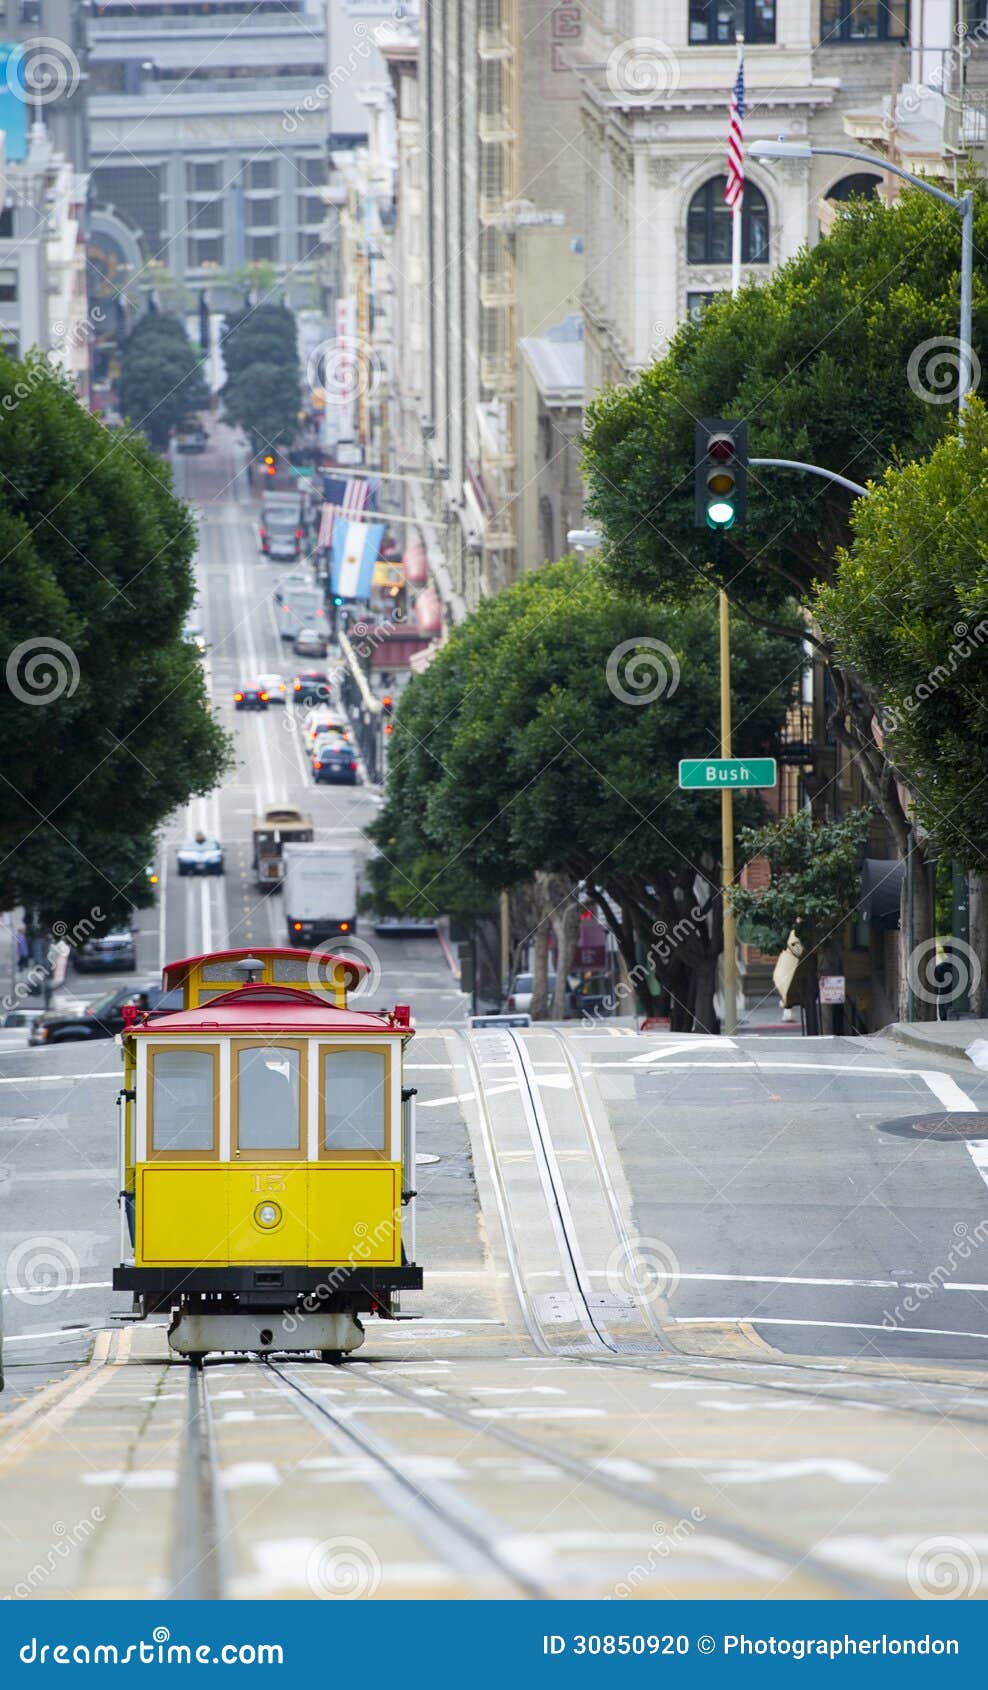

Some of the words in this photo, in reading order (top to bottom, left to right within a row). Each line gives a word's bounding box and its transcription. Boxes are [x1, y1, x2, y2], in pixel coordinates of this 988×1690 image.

[551, 0, 581, 72] EL
[706, 766, 749, 781] Bush
[251, 1174, 287, 1193] 15
